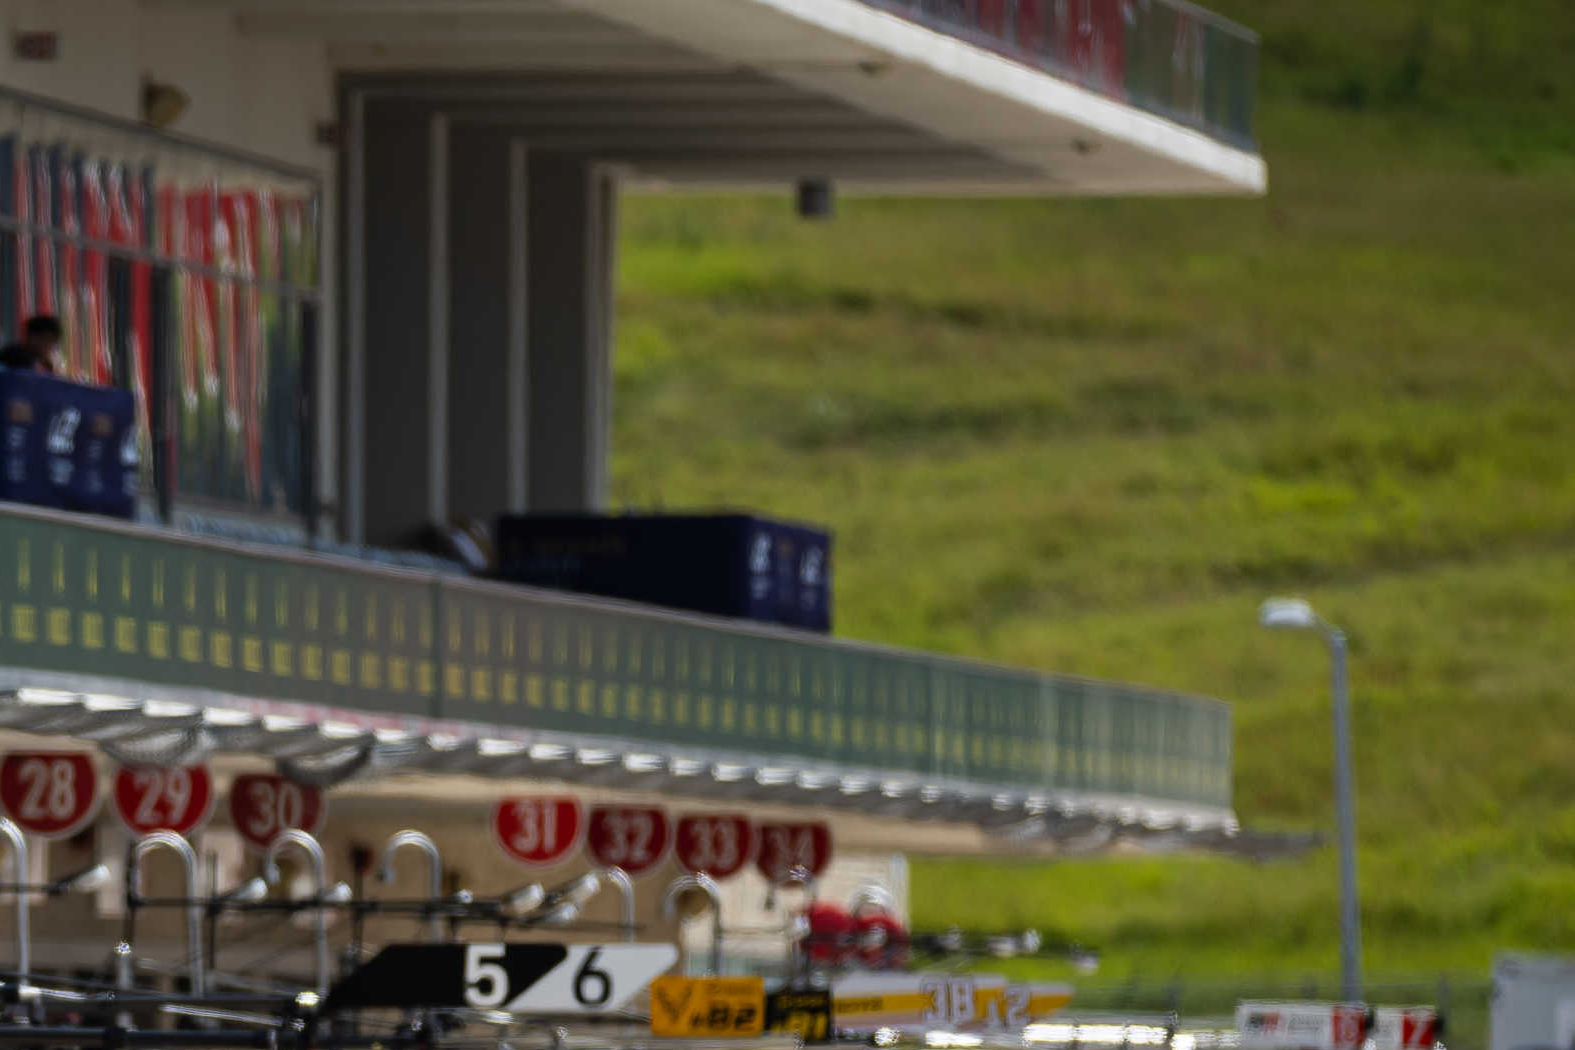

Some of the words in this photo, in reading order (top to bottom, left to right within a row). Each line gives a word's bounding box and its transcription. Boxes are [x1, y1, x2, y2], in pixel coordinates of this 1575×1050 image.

[17, 758, 75, 820] 28
[132, 768, 193, 826] 29
[247, 781, 303, 837] 30
[510, 799, 558, 854] 31
[464, 943, 510, 1008] 5
[575, 944, 612, 1006] 6
